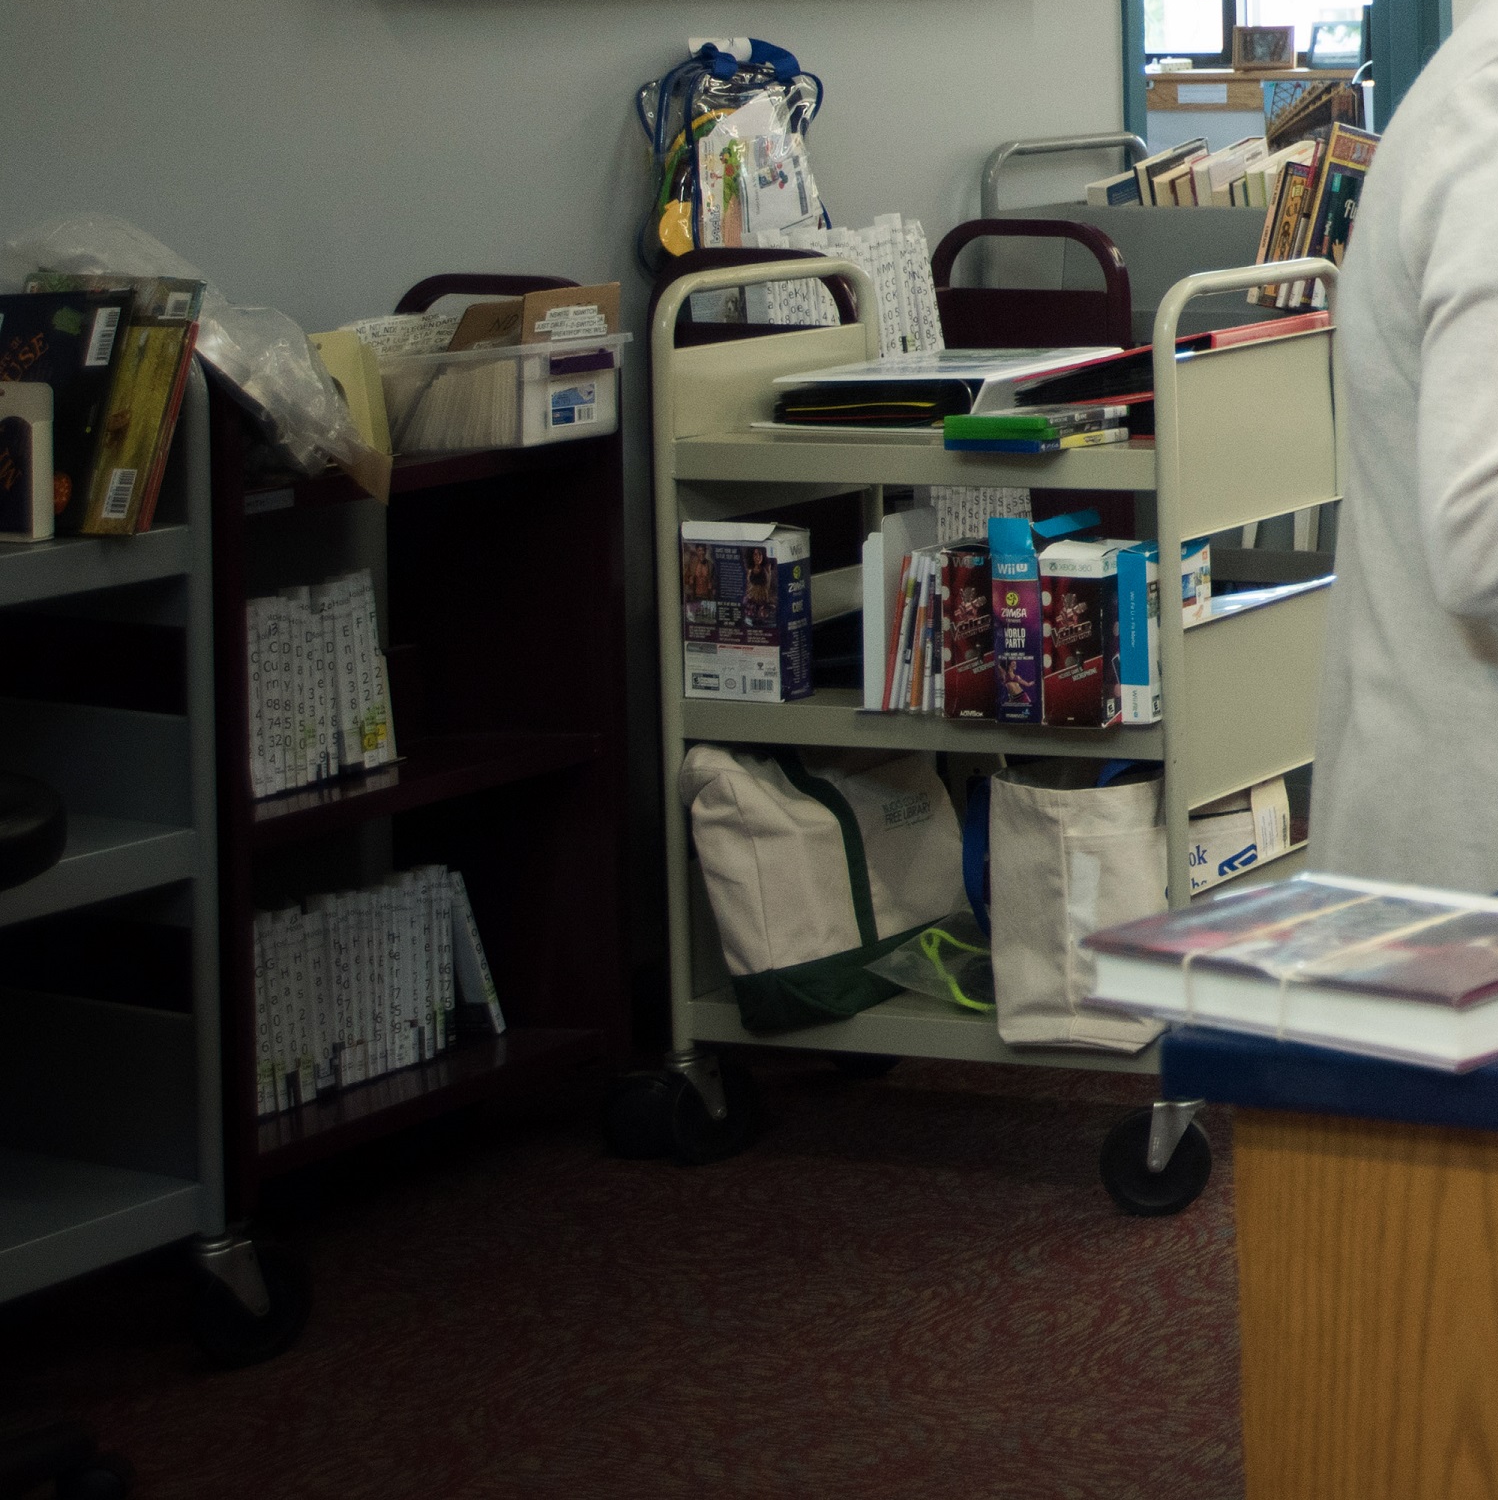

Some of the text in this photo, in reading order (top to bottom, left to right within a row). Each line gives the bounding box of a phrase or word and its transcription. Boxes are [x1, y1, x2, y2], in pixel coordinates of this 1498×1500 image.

[997, 564, 1016, 575] Wii
[1001, 608, 1027, 619] ZUMBA
[1004, 628, 1026, 638] WORLD
[1004, 637, 1026, 649] PARTY
